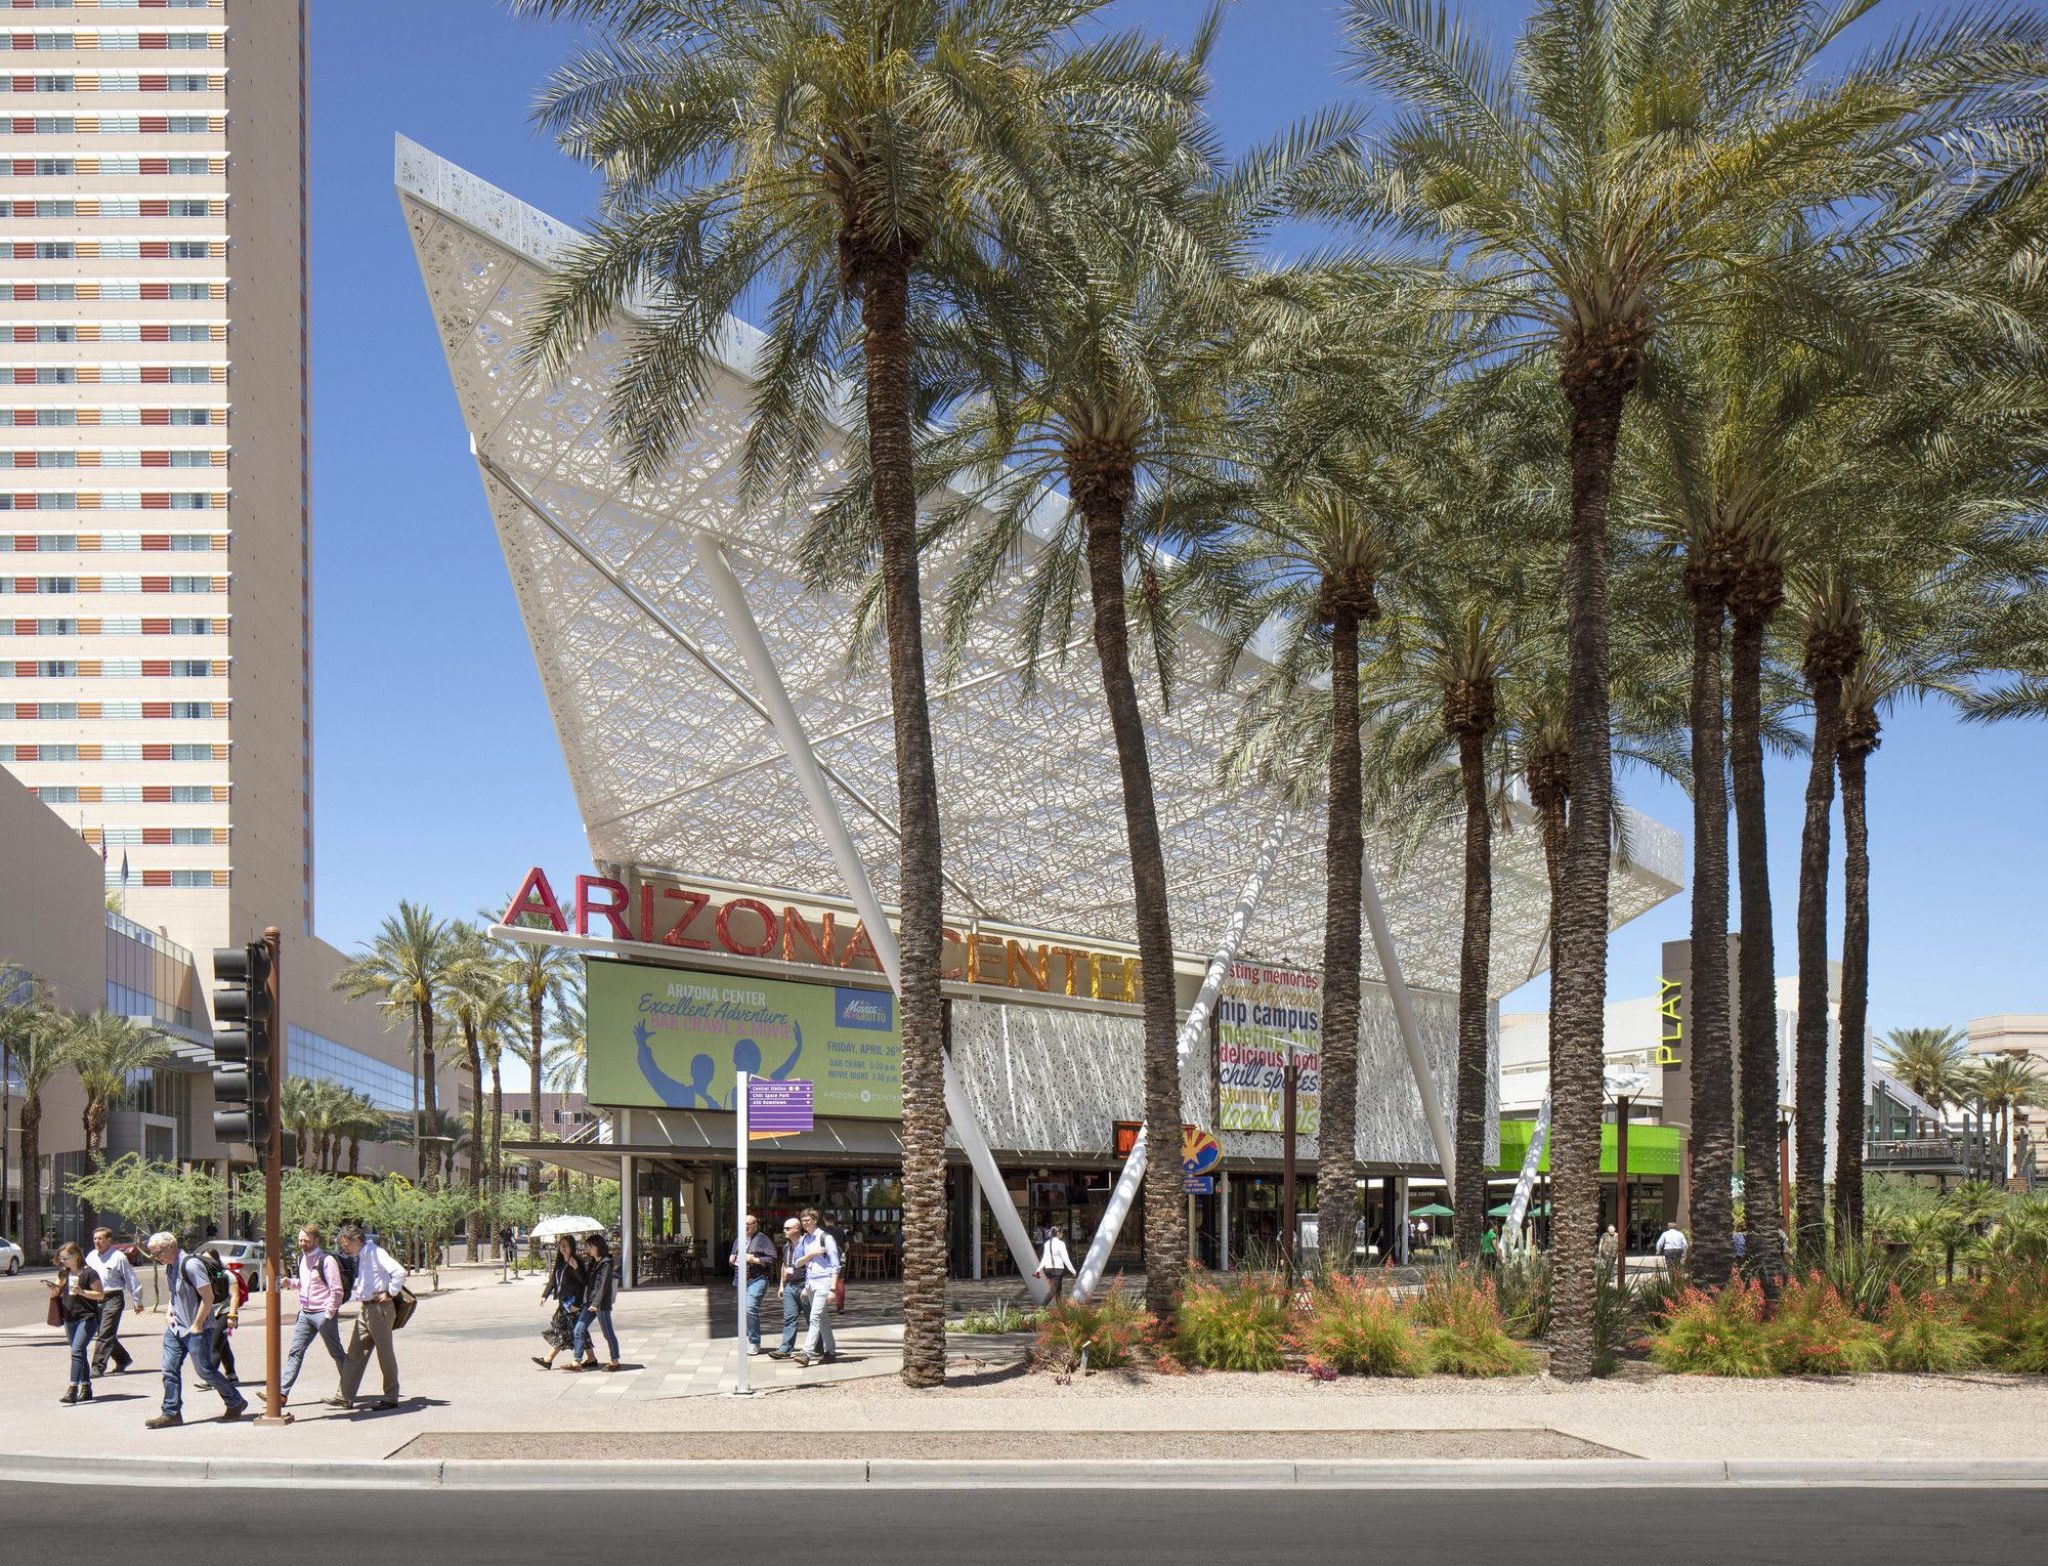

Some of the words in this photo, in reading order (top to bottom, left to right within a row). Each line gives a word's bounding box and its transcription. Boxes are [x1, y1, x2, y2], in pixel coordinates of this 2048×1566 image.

[500, 866, 886, 973] ARIZONA
[1228, 963, 1260, 985] sting
[1263, 968, 1319, 990] memories
[638, 993, 713, 1018] Excellent
[714, 1001, 788, 1025] Adventure
[667, 983, 719, 1001] ARIZONA
[722, 988, 766, 1006] CENTER
[845, 999, 878, 1015] Movies
[651, 1013, 678, 1029] BAR
[684, 1016, 731, 1035] CRAWL
[751, 1022, 791, 1040] MOVIE
[1219, 994, 1247, 1027] hip
[1252, 1004, 1319, 1033] campus
[1655, 975, 1682, 1065] PLAY
[827, 1041, 858, 1054] FRIDAY,
[860, 1043, 884, 1056] APRIL
[1219, 1041, 1284, 1068] delicious
[1294, 1052, 1318, 1071] ood
[1219, 1054, 1263, 1088] chill
[1263, 1067, 1319, 1099] spes
[1220, 1103, 1276, 1131] local
